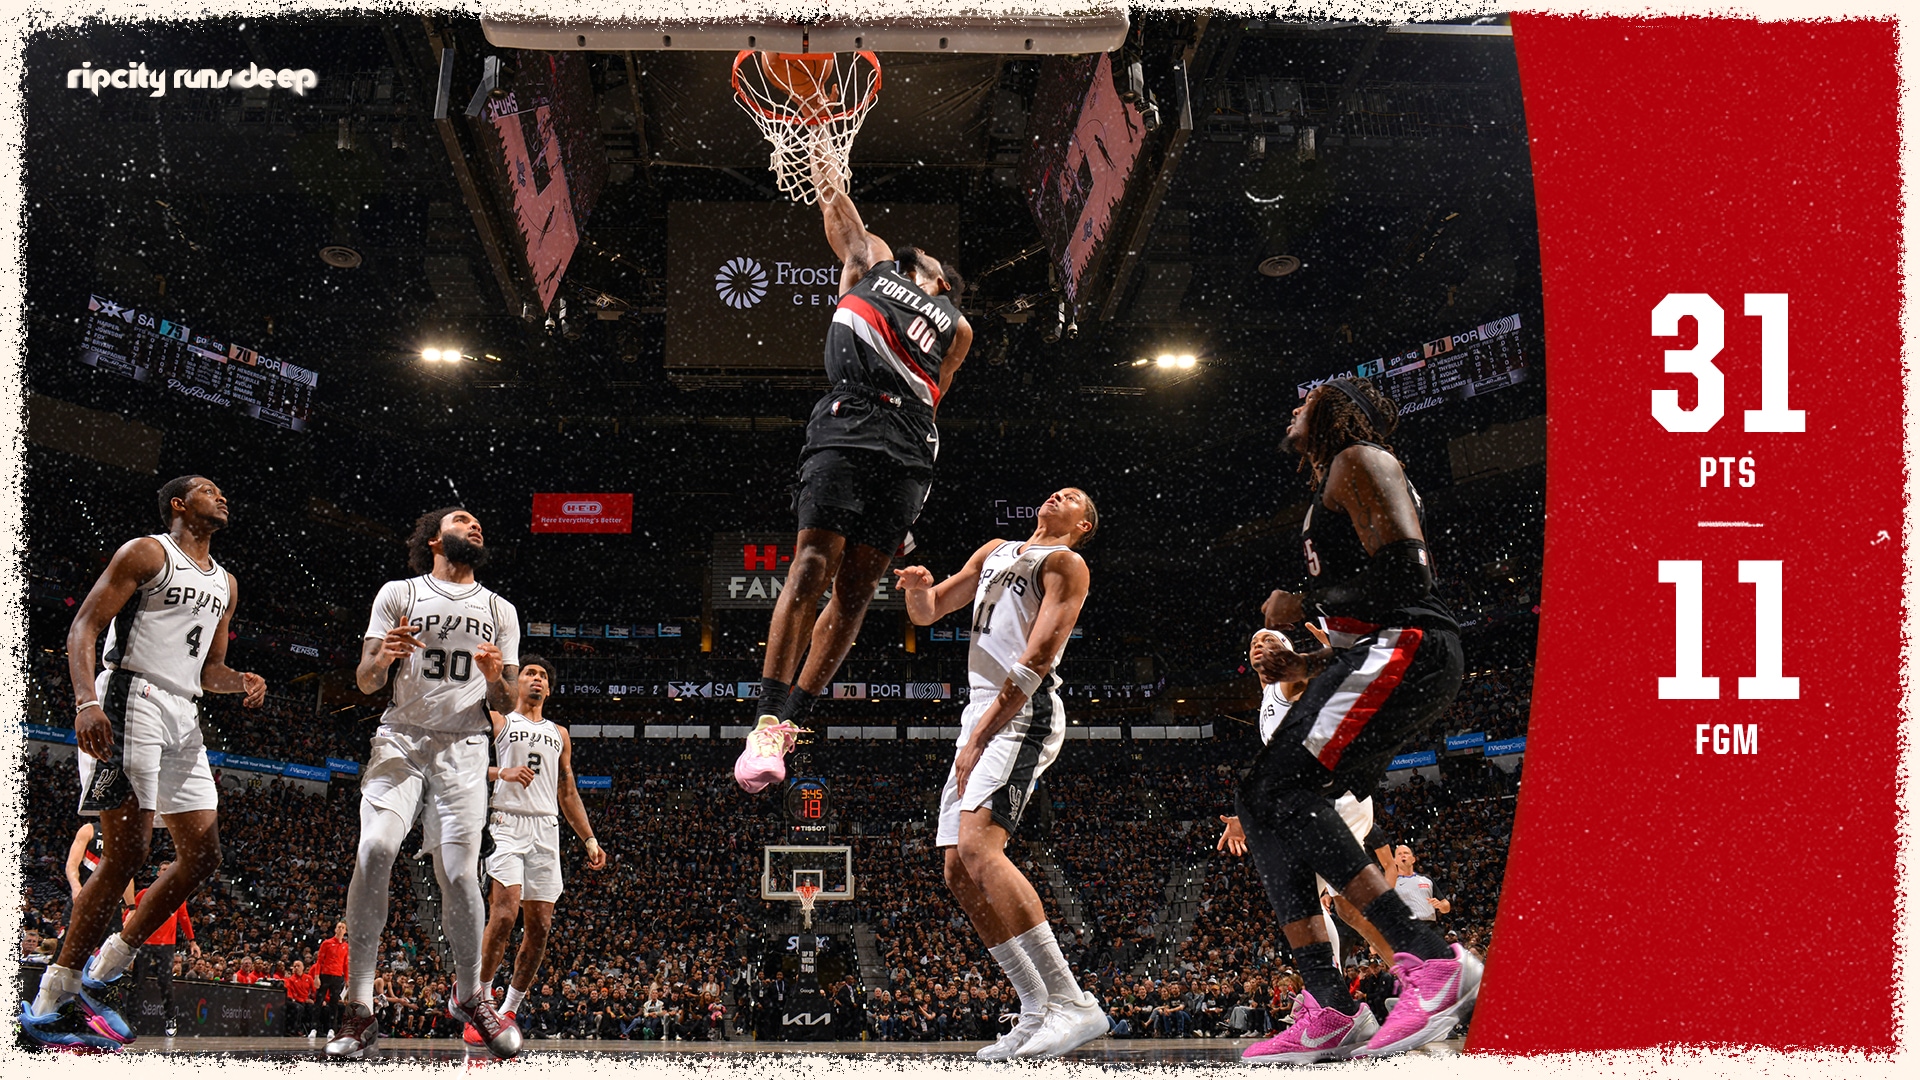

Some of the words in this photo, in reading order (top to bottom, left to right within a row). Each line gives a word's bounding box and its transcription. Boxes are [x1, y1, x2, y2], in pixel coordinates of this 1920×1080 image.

[775, 261, 838, 286] Frost
[793, 294, 838, 306] CEN
[871, 276, 951, 333] PORTLAND
[94, 326, 123, 339] JOHNSON
[137, 313, 156, 329] SA
[166, 322, 182, 339] 75
[906, 316, 938, 354] 00
[236, 347, 252, 363] 70
[258, 356, 280, 373] POR
[1362, 361, 1379, 377] 75
[1429, 340, 1446, 355] 70
[1452, 330, 1479, 347] POR
[1436, 351, 1468, 365] HENDERSON
[167, 379, 231, 408] ProBaller
[1398, 397, 1444, 416] oBaller
[1304, 538, 1321, 577] 5
[410, 615, 493, 642] SPURS
[974, 602, 996, 635] 11
[185, 624, 204, 659] 4
[422, 648, 472, 682] 30
[608, 684, 627, 695] 50.0
[714, 683, 735, 697] SA
[748, 684, 760, 696] 75
[843, 684, 857, 697] 70
[871, 684, 900, 697] POR
[510, 731, 560, 753] SPURS
[1488, 742, 1526, 751] VictoryCapit
[527, 752, 541, 775] 2
[801, 789, 823, 800] 3:45
[804, 799, 821, 819] 18
[142, 1000, 166, 1016] Searc
[222, 1005, 243, 1019] Search
[782, 1012, 831, 1025] KIA
